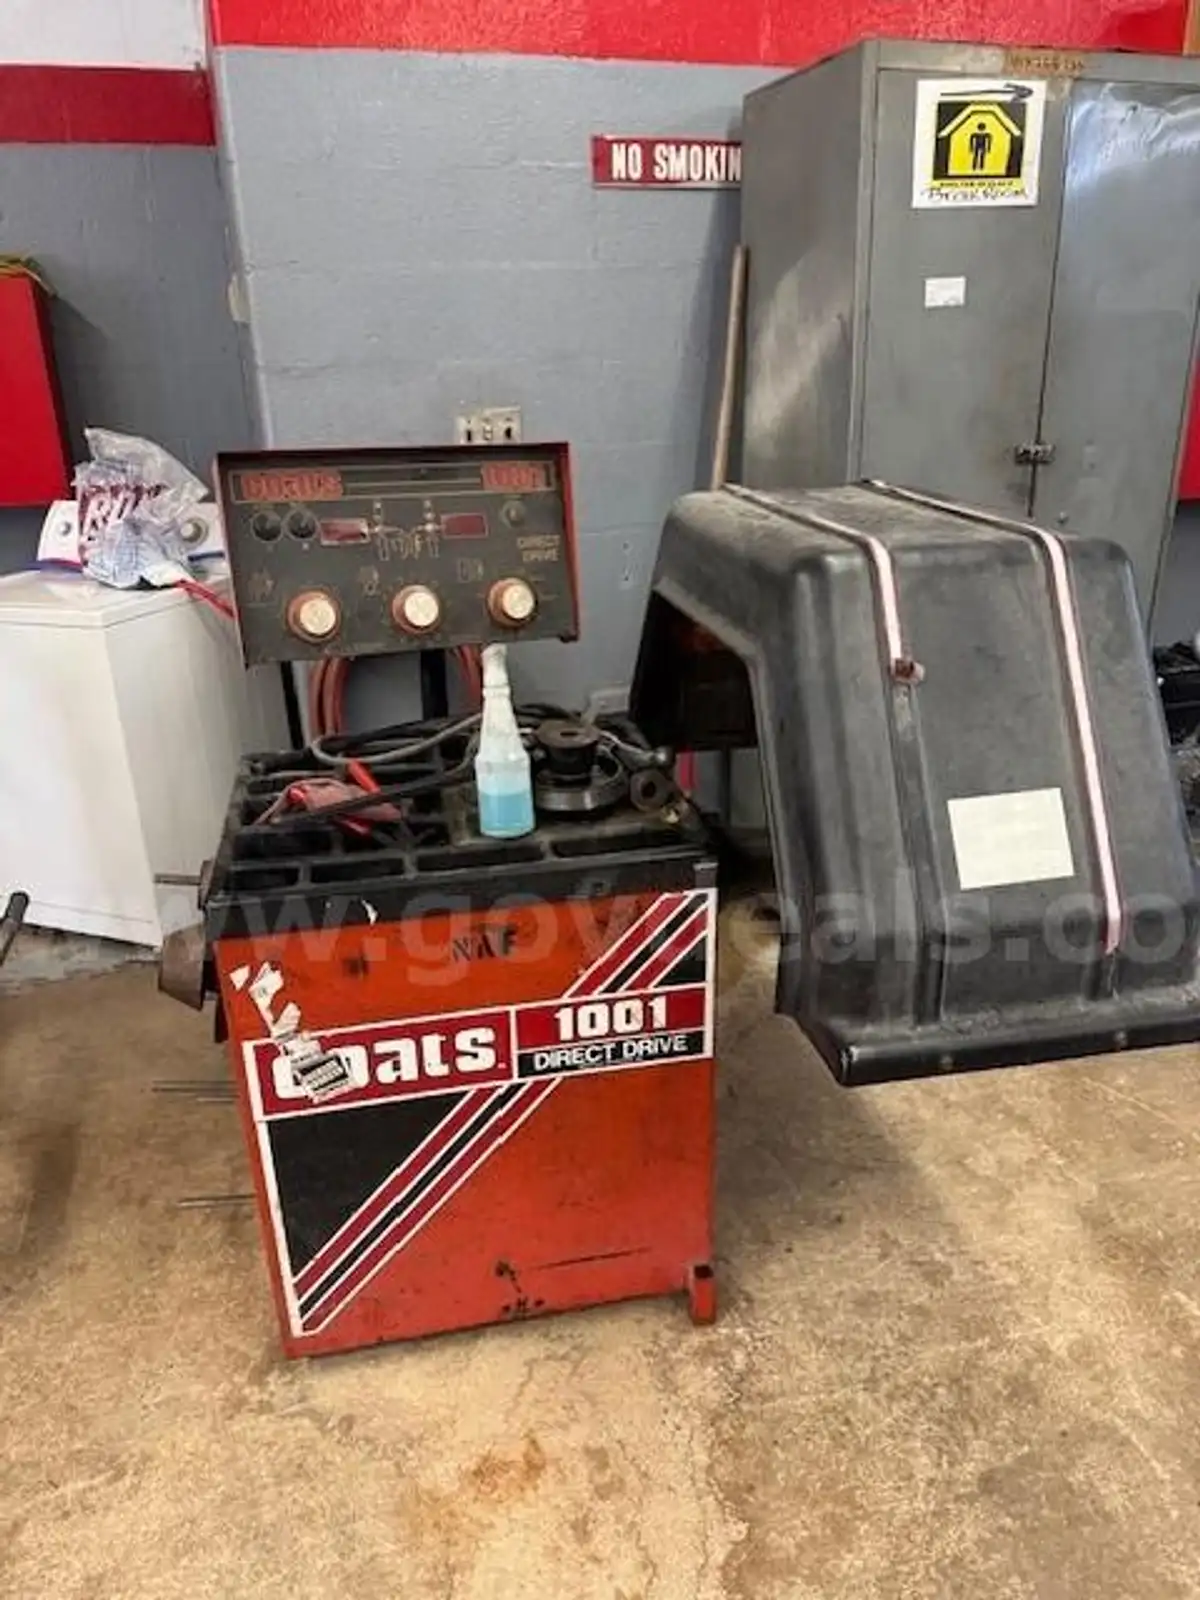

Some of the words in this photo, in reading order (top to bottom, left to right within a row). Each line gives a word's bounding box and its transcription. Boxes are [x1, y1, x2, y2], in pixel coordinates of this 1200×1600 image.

[612, 143, 643, 180] NO
[653, 143, 741, 181] SMOKIN
[554, 996, 667, 1041] 1001
[534, 1043, 616, 1071] DIRECT
[622, 1034, 688, 1059] DRIVE
